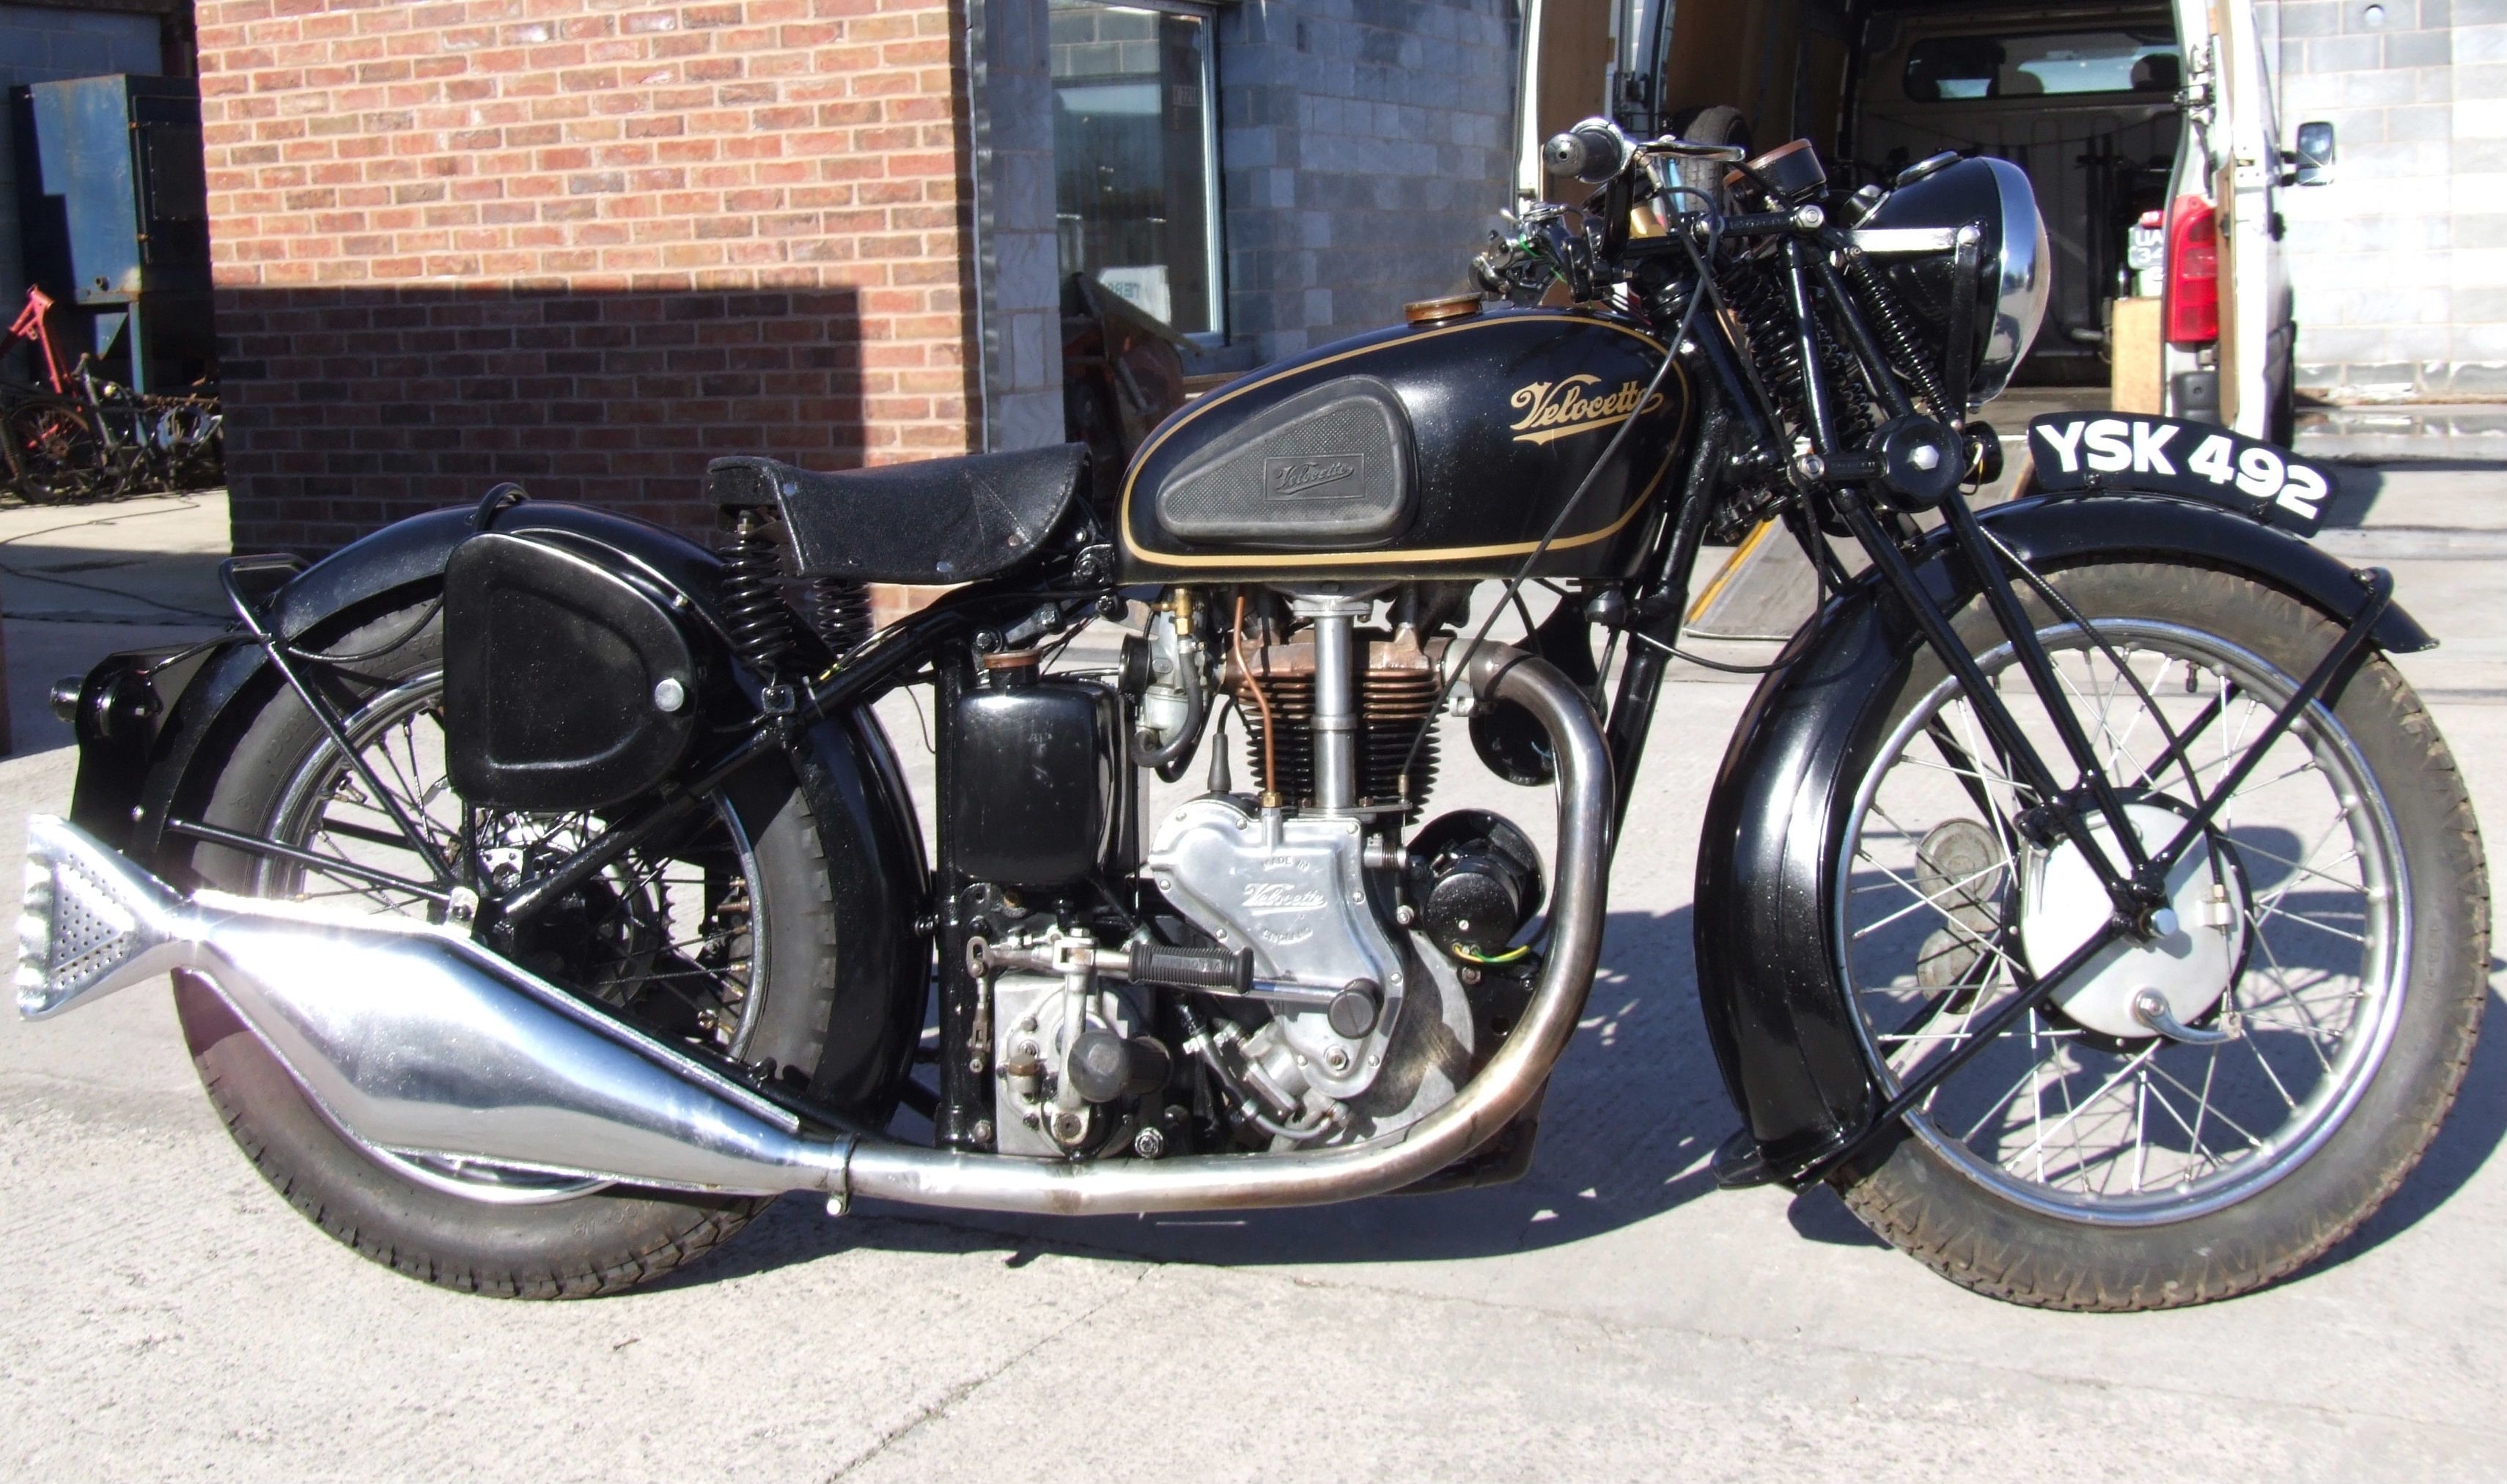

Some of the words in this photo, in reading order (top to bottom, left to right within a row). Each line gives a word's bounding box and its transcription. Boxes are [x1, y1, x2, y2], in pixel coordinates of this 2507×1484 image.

[1276, 462, 1354, 491] Velocette
[2036, 418, 2180, 476] YSK
[2187, 434, 2327, 520] 492
[1241, 882, 1328, 911] Velocette
